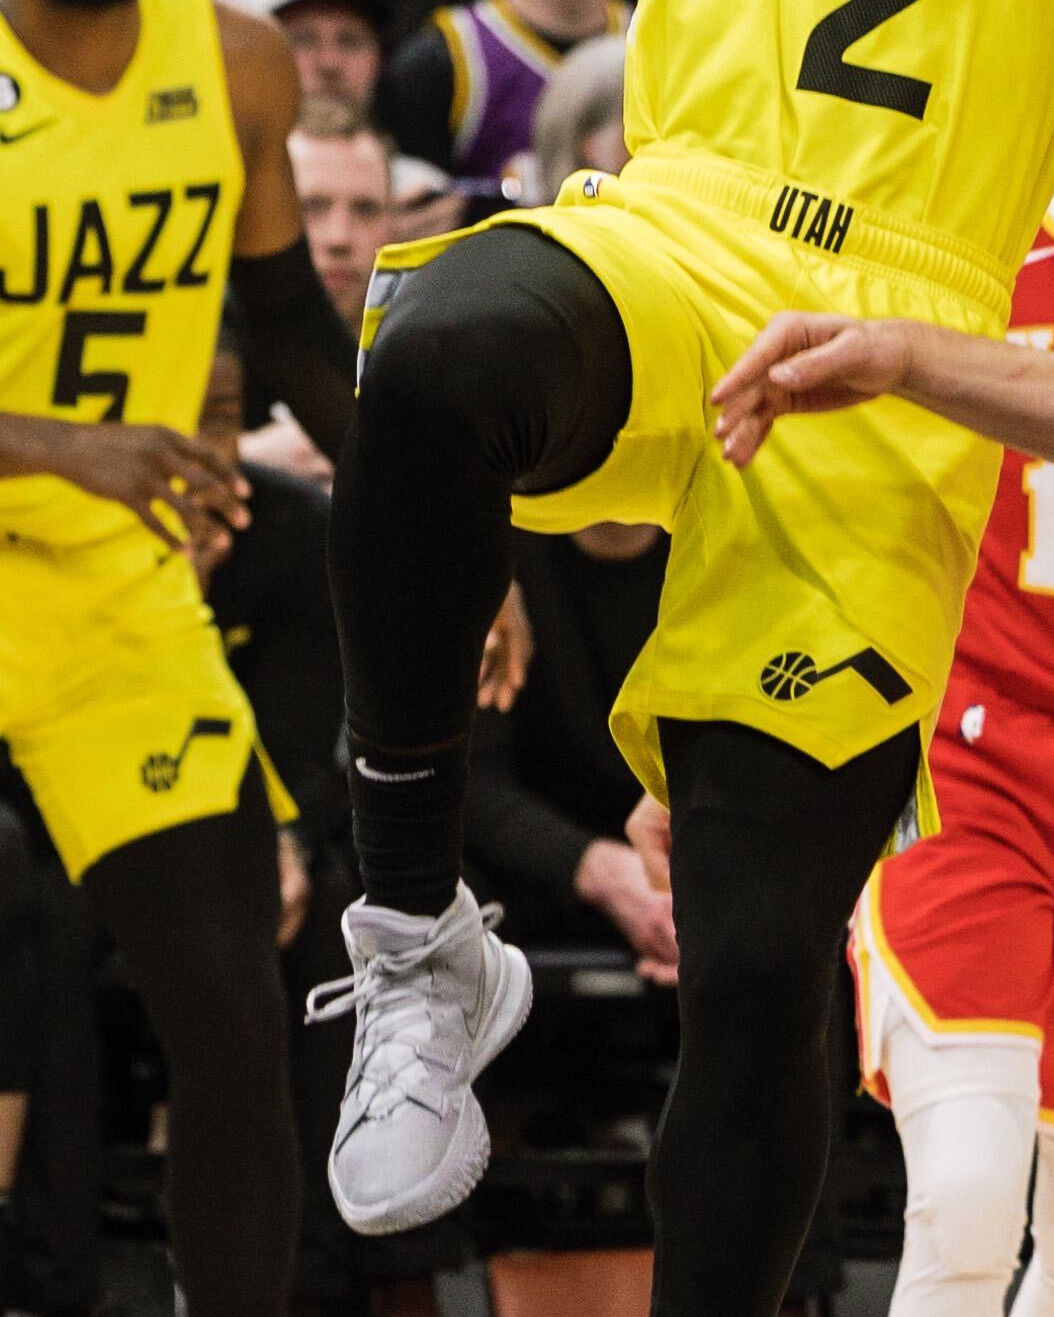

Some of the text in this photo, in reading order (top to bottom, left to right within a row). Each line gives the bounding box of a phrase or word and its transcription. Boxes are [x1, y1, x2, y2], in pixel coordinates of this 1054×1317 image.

[0, 182, 221, 306] JAZZ
[769, 185, 855, 255] UTAH
[53, 310, 148, 423] 5
